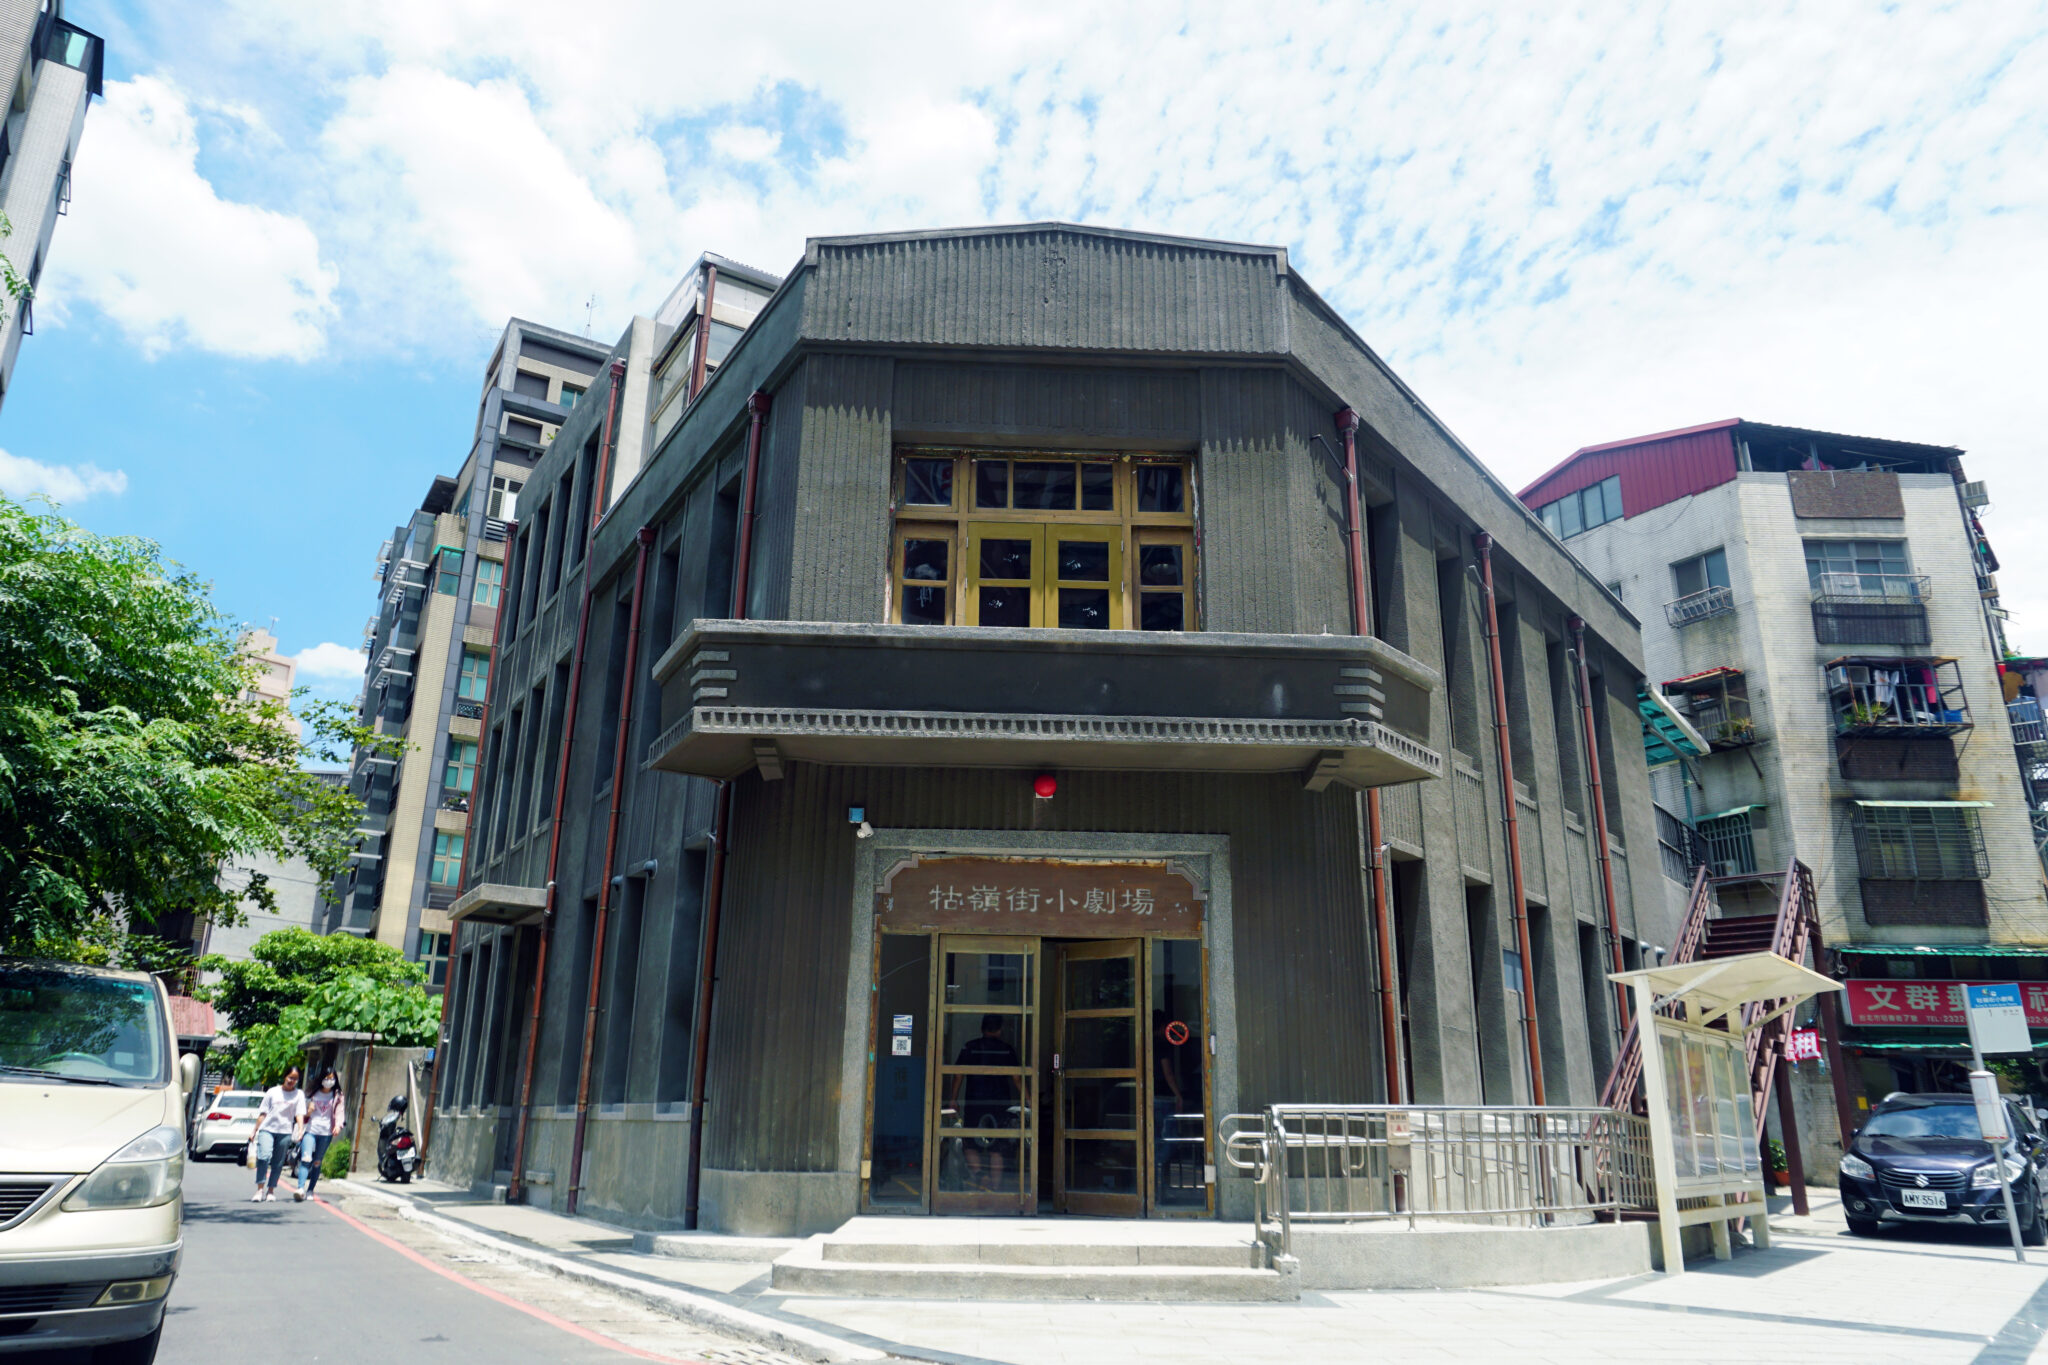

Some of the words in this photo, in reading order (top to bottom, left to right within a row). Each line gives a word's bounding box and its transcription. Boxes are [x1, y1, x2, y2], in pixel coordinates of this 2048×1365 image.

[928, 884, 1155, 915] 牯嶺街小劇場
[1795, 1031, 1822, 1059] 租
